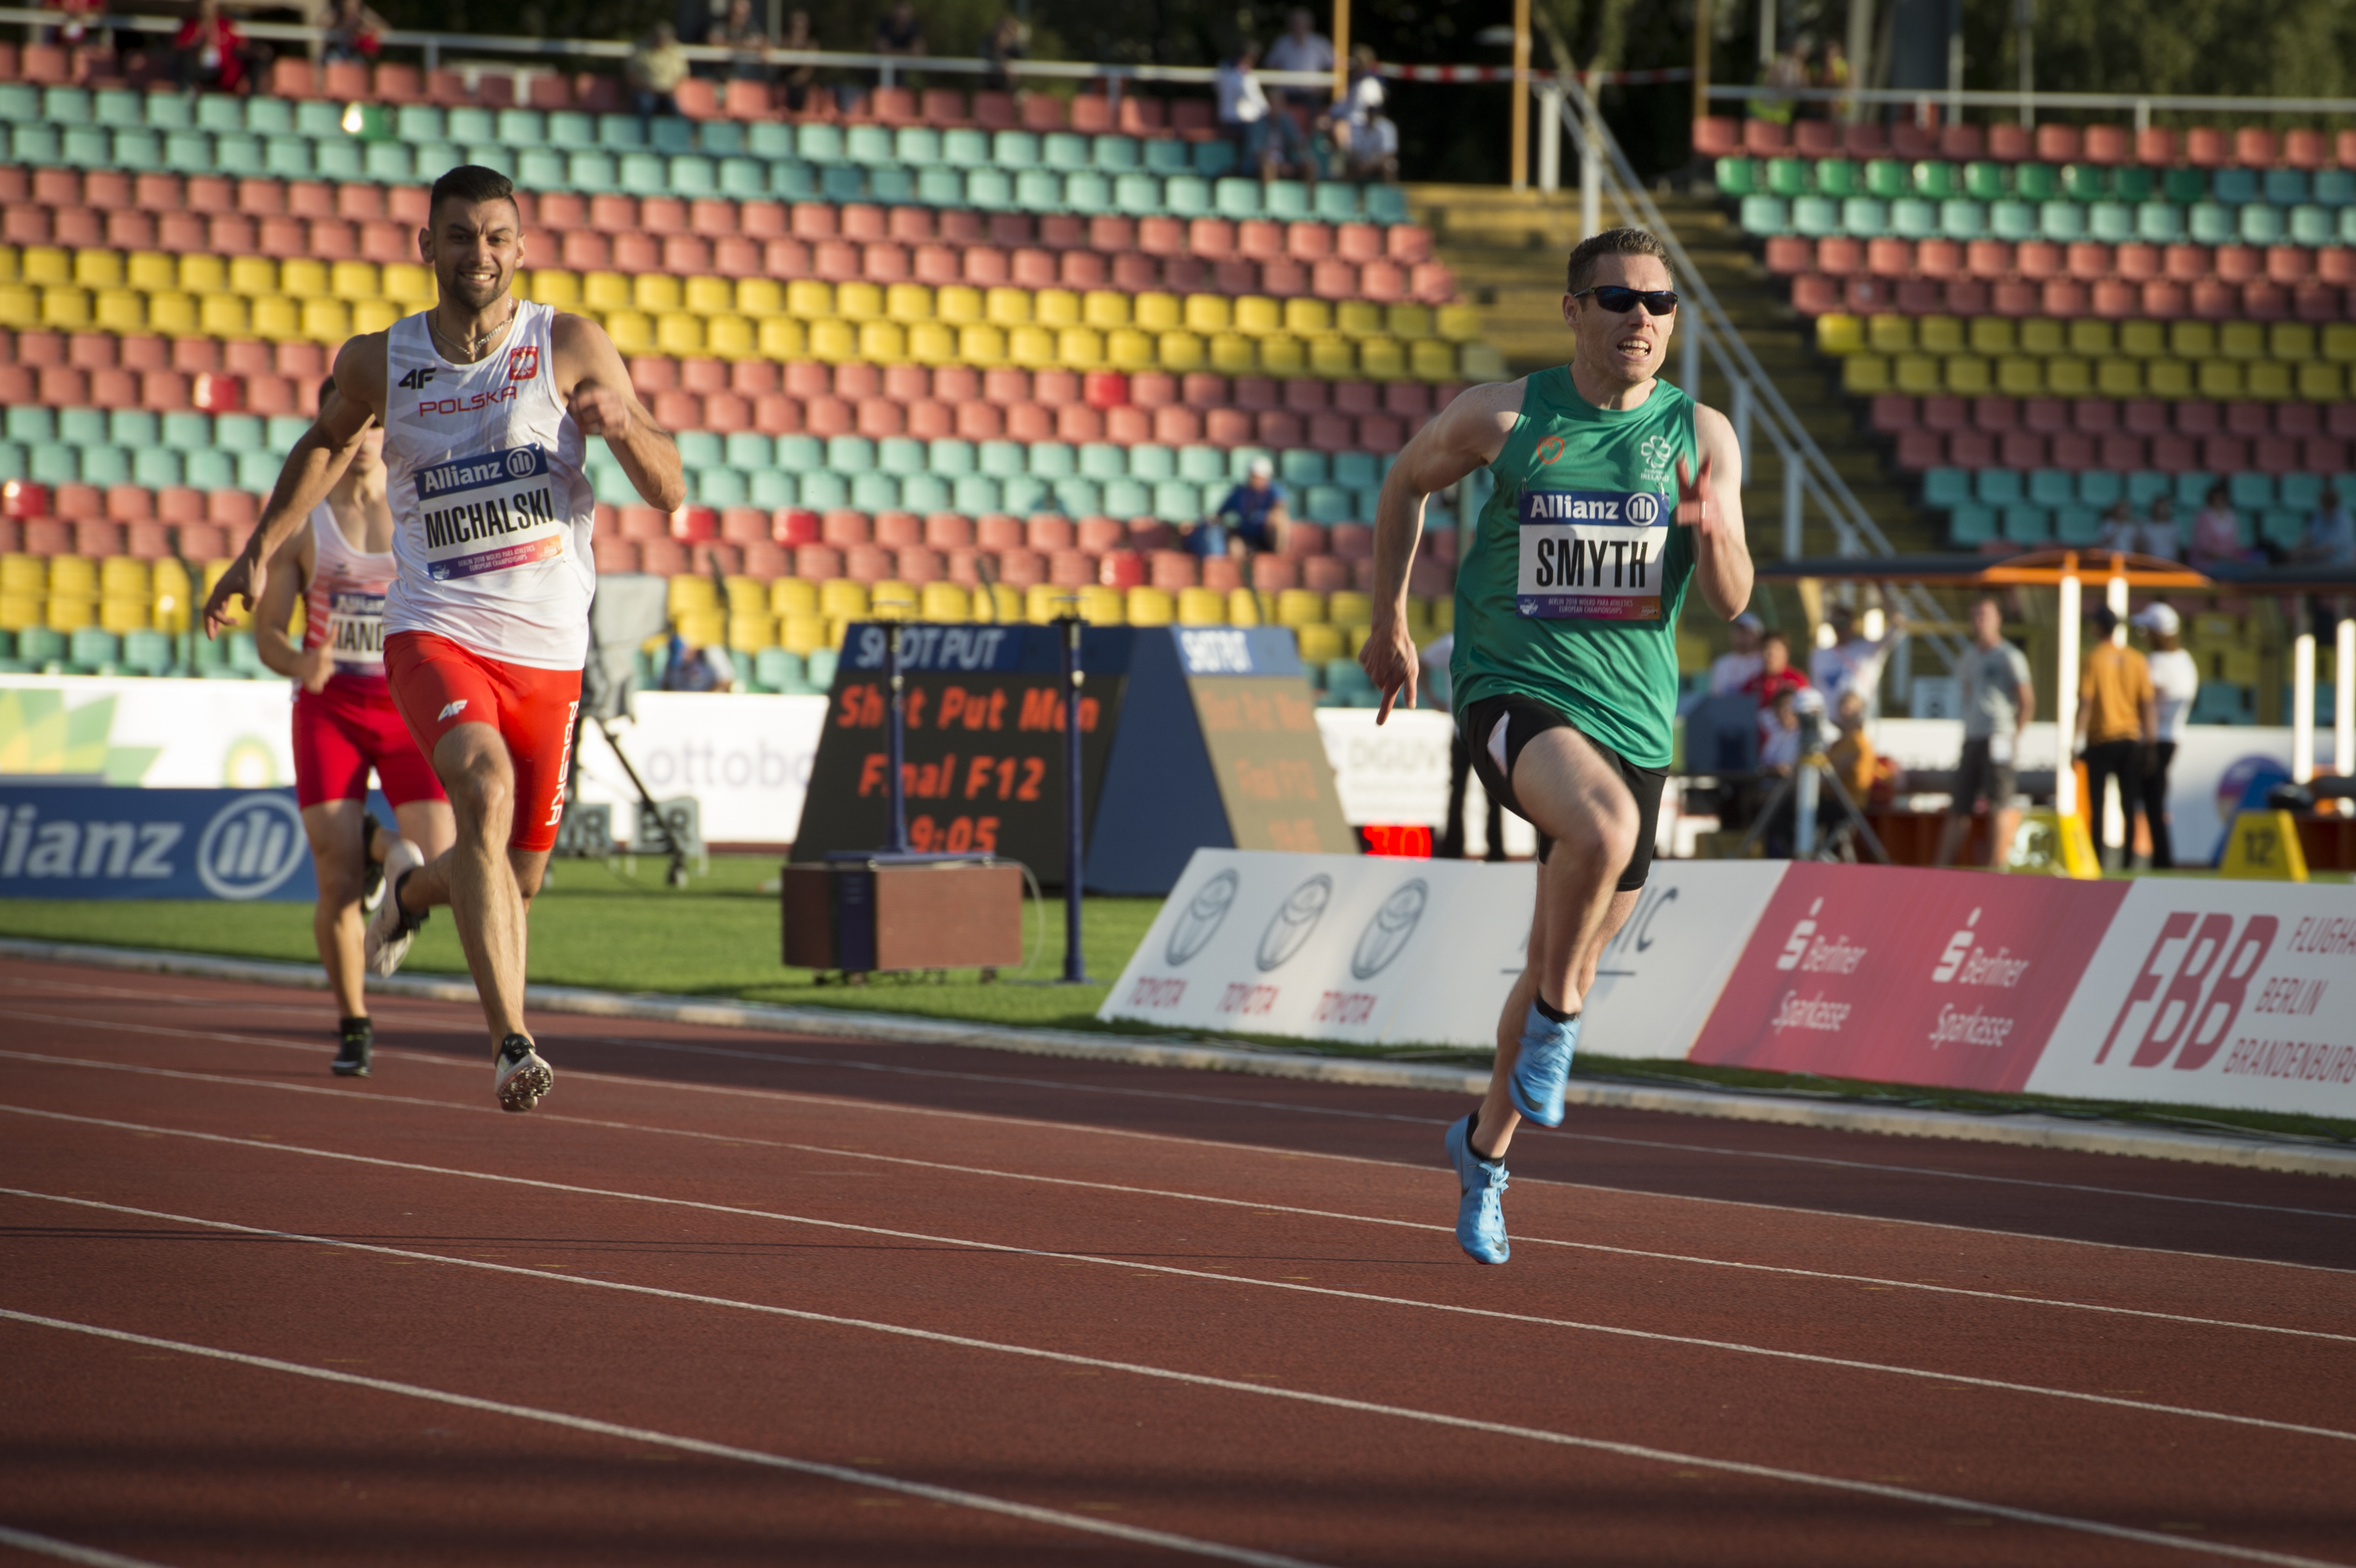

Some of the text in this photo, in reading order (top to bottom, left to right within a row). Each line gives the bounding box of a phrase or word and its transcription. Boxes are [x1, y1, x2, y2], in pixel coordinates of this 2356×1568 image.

[398, 367, 437, 389] 4F
[419, 386, 518, 418] POLSKA
[424, 461, 503, 493] Allianz
[1641, 473, 1670, 483] IRELAND
[425, 487, 554, 550] MICHALSKI
[1531, 495, 1619, 520] Allianz
[1536, 537, 1648, 588] SMYTH
[1583, 606, 1622, 615] CHAMPIONSHIPS
[1597, 598, 1609, 607] PARA
[1609, 598, 1633, 608] ATHLETICS
[938, 627, 1007, 670] PUT
[836, 682, 926, 729] Sht
[937, 685, 1007, 730] Put
[546, 700, 580, 826] POLSKA
[858, 751, 1046, 802] Fnal F12
[0, 803, 183, 879] ianz
[2244, 827, 2274, 863] 12
[1802, 934, 1868, 975] Berliner
[1959, 946, 2029, 988] Berliner
[1125, 976, 1188, 1008] TOYOTA
[1216, 982, 1279, 1016] TOYOTA
[1311, 989, 1377, 1025] TOYOTA
[2093, 911, 2280, 1071] FBB
[2254, 977, 2329, 1015] BERLIN
[1771, 989, 1851, 1036] Sparkasse
[1928, 1002, 2014, 1051] Sparkasse
